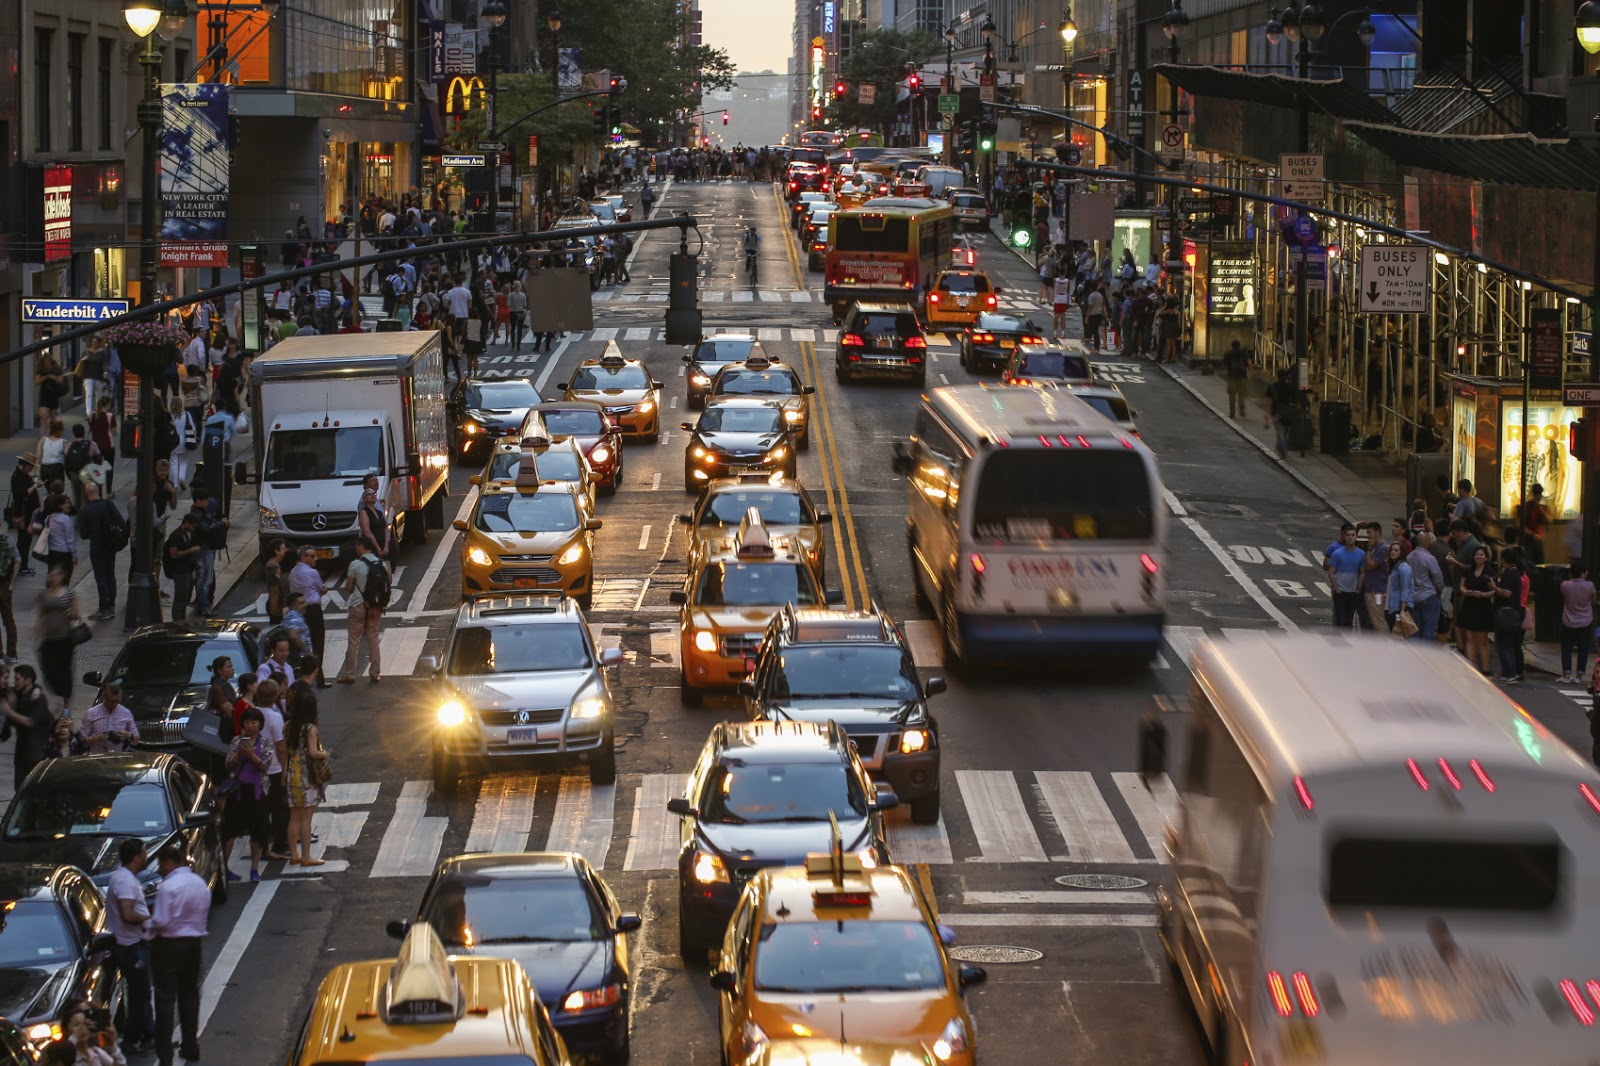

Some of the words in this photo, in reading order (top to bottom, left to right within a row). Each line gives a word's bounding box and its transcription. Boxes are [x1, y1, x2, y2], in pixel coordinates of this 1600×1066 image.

[434, 31, 443, 74] NAILS
[447, 47, 462, 74] etro
[1129, 71, 1143, 117] ATM
[443, 156, 471, 165] Madison
[471, 156, 484, 165] Ave
[1288, 158, 1317, 166] BUSES
[1291, 168, 1314, 176] ONLY
[161, 251, 188, 262] Knight
[190, 251, 213, 261] Frank
[1373, 251, 1417, 262] BUSES
[1378, 265, 1411, 277] ONLY
[25, 304, 97, 319] Vanderbilt
[99, 305, 126, 319] Ave
[1569, 390, 1592, 400] ONE
[1507, 407, 1556, 425] GET
[1560, 407, 1578, 424] A
